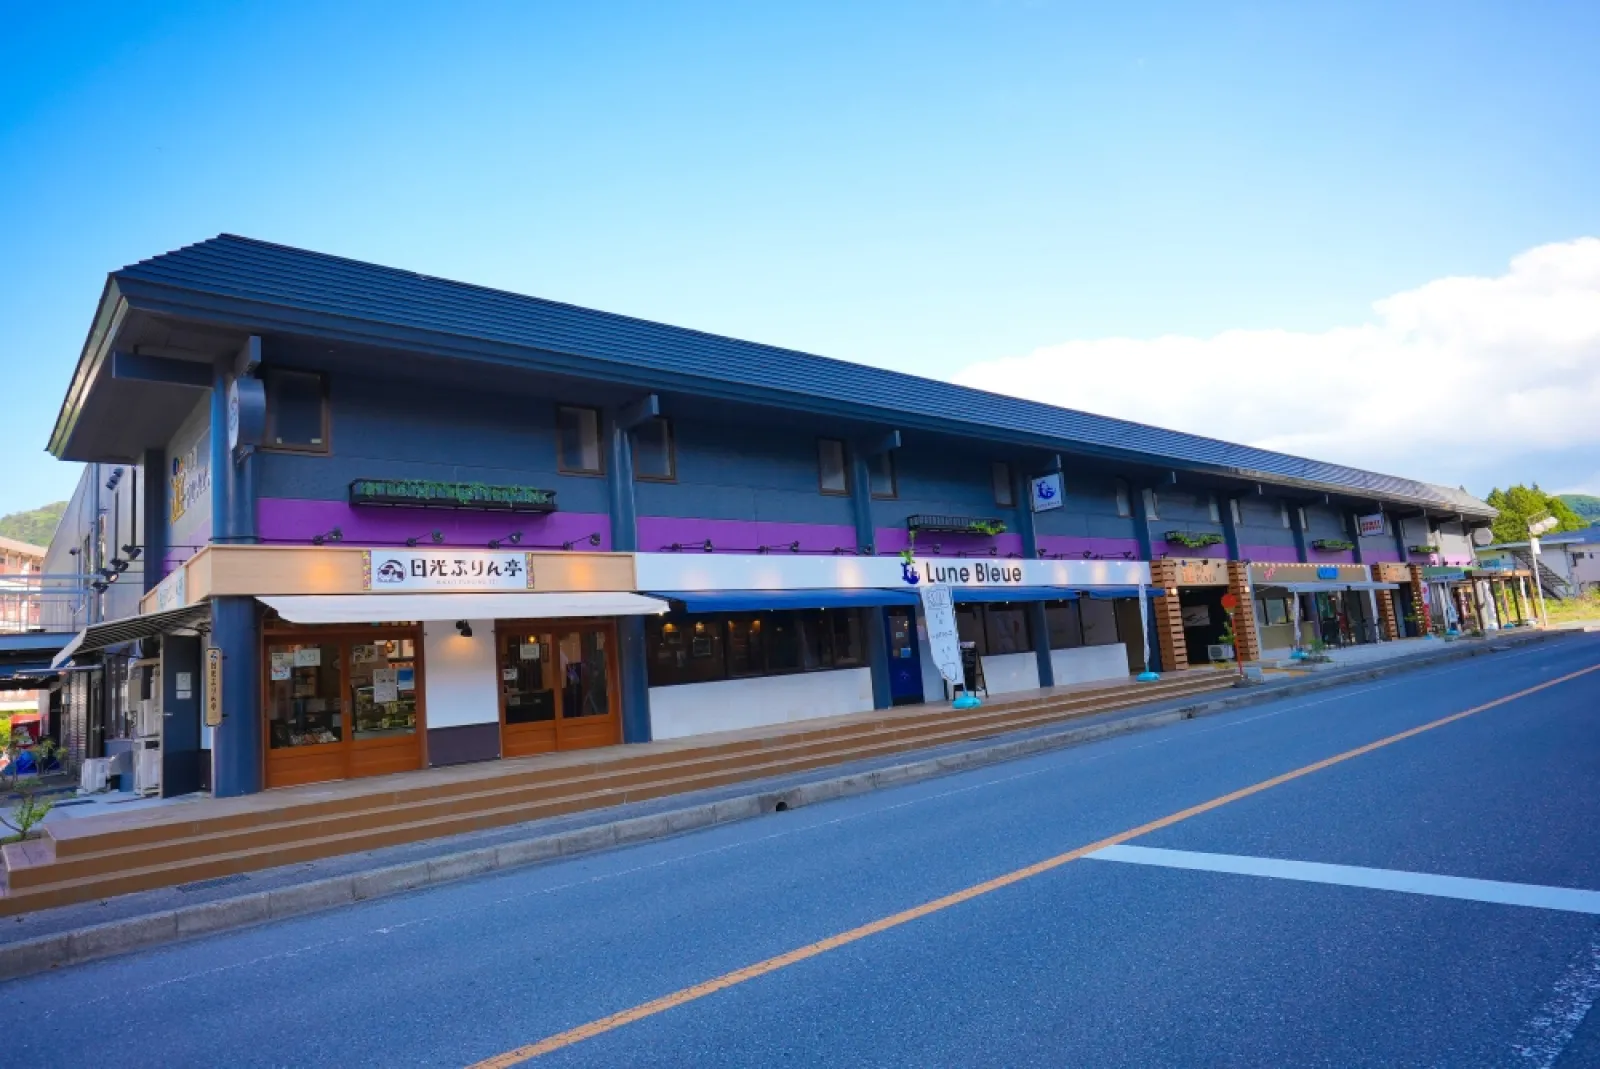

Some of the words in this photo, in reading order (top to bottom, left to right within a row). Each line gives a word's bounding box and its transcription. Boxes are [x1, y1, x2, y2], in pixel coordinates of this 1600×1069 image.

[410, 558, 523, 577] 日光ぷりん亭
[925, 562, 970, 583] Lune
[975, 562, 1022, 583] Bleue
